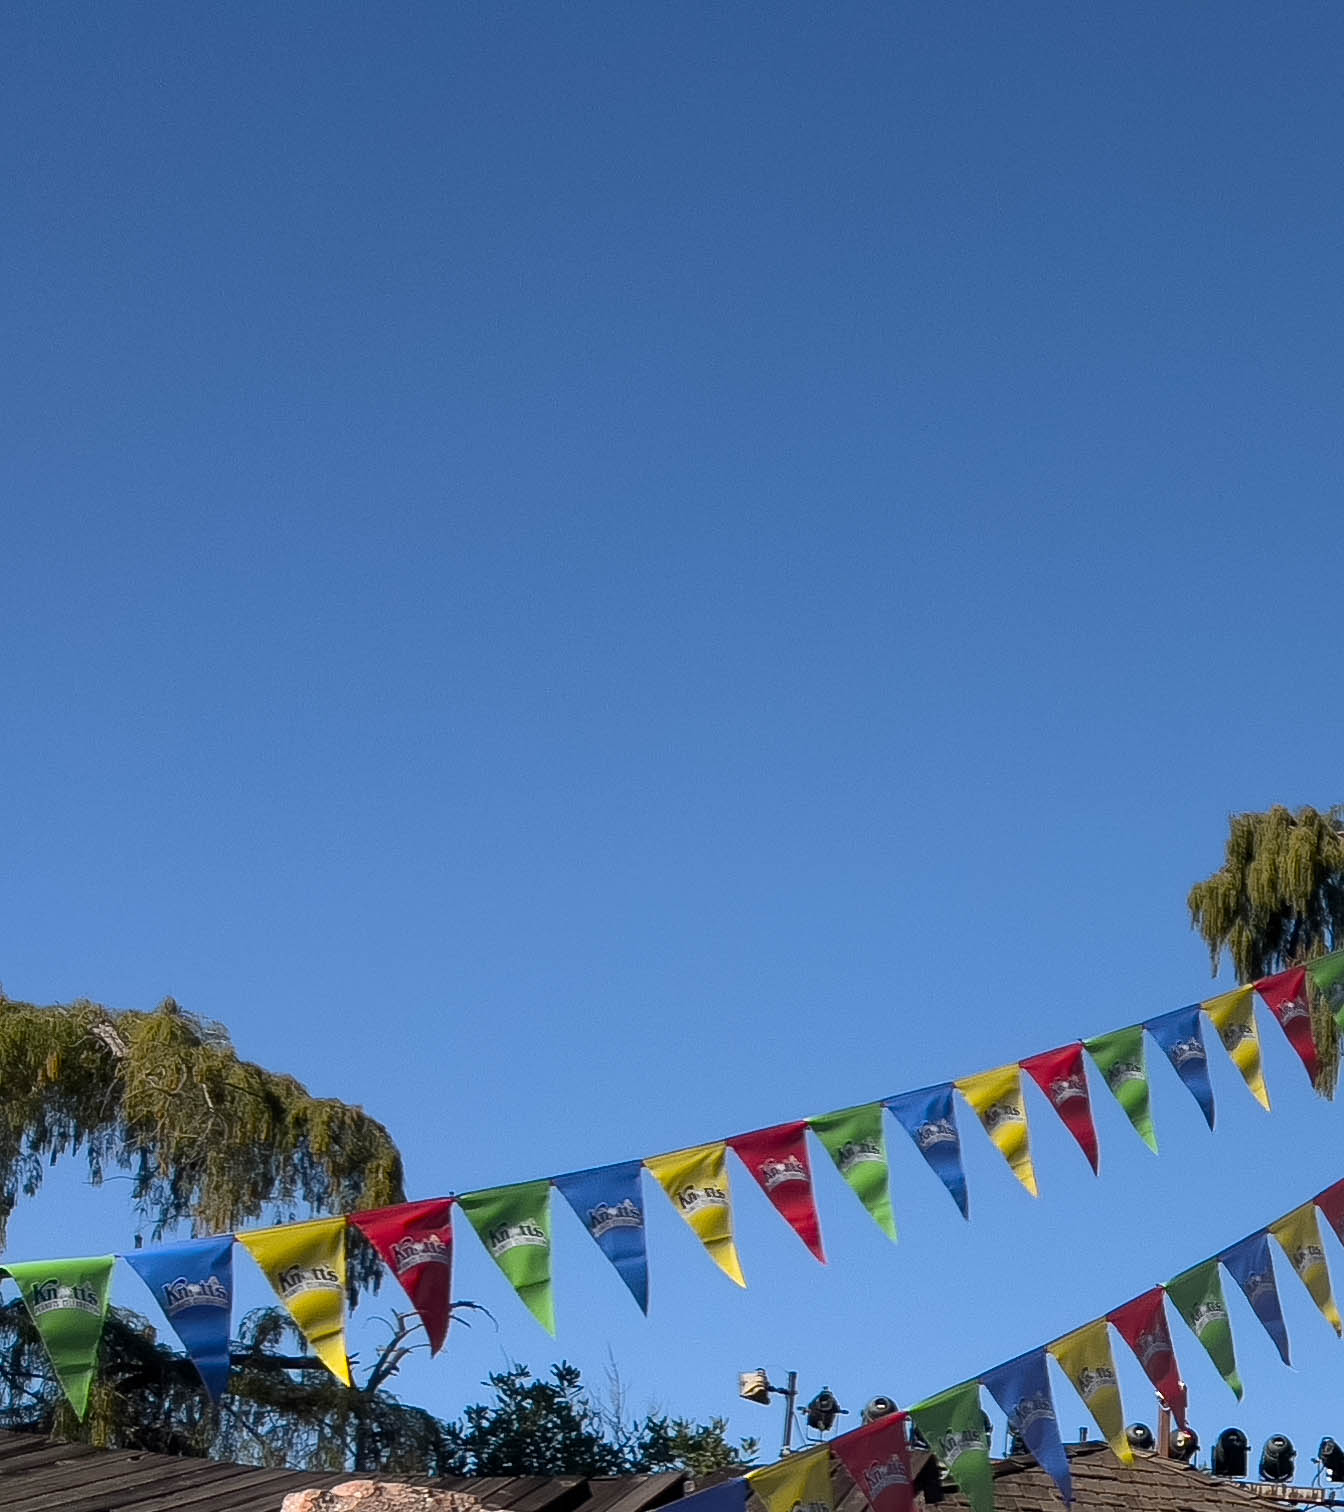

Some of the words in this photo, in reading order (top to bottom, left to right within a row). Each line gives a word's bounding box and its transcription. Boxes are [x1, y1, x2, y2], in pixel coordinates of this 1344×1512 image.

[839, 1141, 881, 1164] Kntt's
[678, 1186, 725, 1208] Kntt's
[589, 1201, 640, 1229] Kntt's
[489, 1221, 544, 1248] Kntt's
[391, 1237, 449, 1266] Kntt's
[278, 1265, 339, 1291] Kntt's
[33, 1279, 98, 1305] Kntt's
[163, 1278, 227, 1306] Kntt's
[940, 1430, 979, 1455] Kntt's
[866, 1457, 906, 1486] Kntt's
